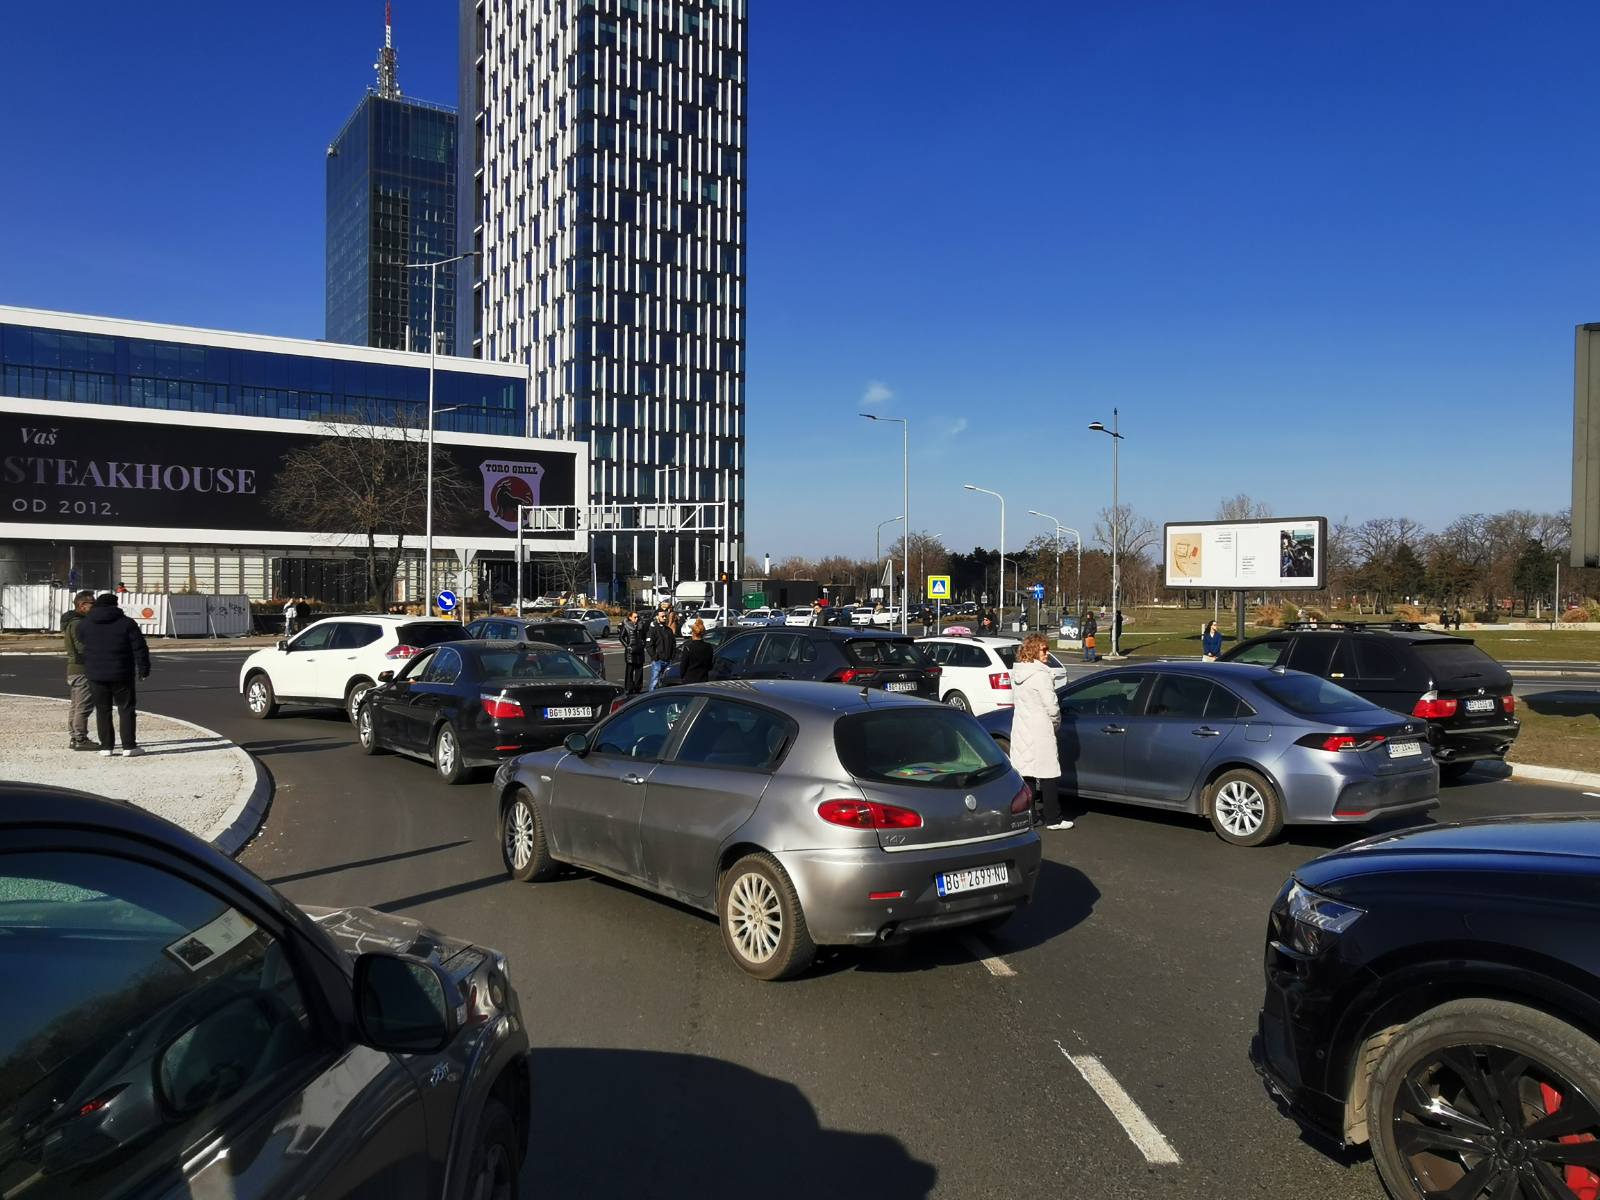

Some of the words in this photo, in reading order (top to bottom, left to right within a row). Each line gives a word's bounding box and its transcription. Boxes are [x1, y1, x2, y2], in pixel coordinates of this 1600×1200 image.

[20, 427, 59, 446] Vaš
[3, 456, 257, 494] STEAKHOUSE
[485, 463, 510, 473] TORO
[12, 498, 47, 513] OD
[58, 500, 120, 515] 2012.
[945, 873, 960, 891] BG
